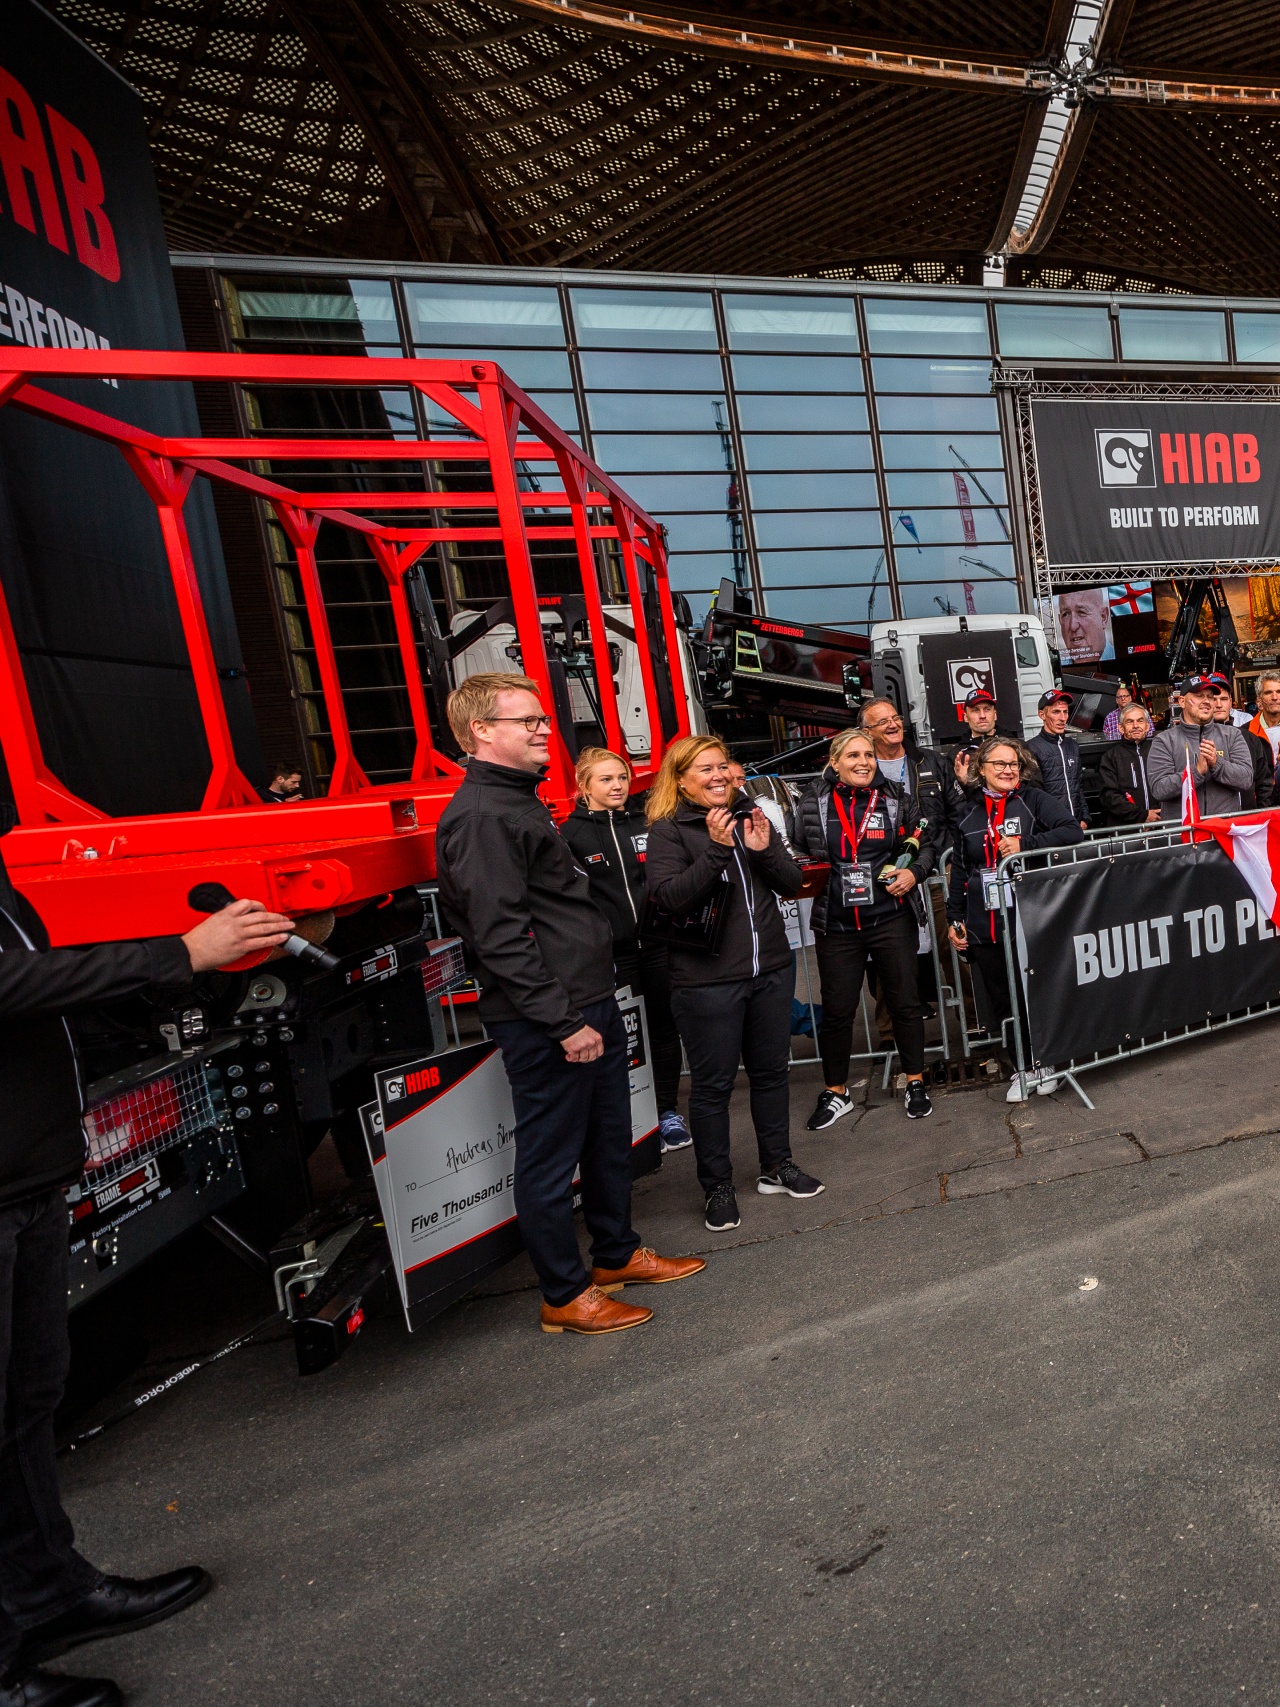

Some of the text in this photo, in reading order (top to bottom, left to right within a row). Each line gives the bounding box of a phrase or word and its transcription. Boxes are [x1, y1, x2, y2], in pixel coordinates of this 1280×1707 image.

[0, 65, 121, 283] AB
[1159, 432, 1261, 484] HIAB
[1109, 505, 1260, 528] BUILT TO PERFORM
[761, 622, 804, 638] ZETTERBERGS
[866, 829, 885, 839] HIAB
[1073, 914, 1174, 986] BUILT
[1183, 904, 1226, 958] TO
[405, 1066, 440, 1095] HIAB
[447, 1139, 494, 1173] Andreas
[405, 1181, 417, 1193] TO
[411, 1211, 439, 1234] Five
[442, 1177, 503, 1218] Thousand
[91, 1199, 153, 1239] Factory Installation Center
[134, 1362, 201, 1406] VIDEOFORCE
